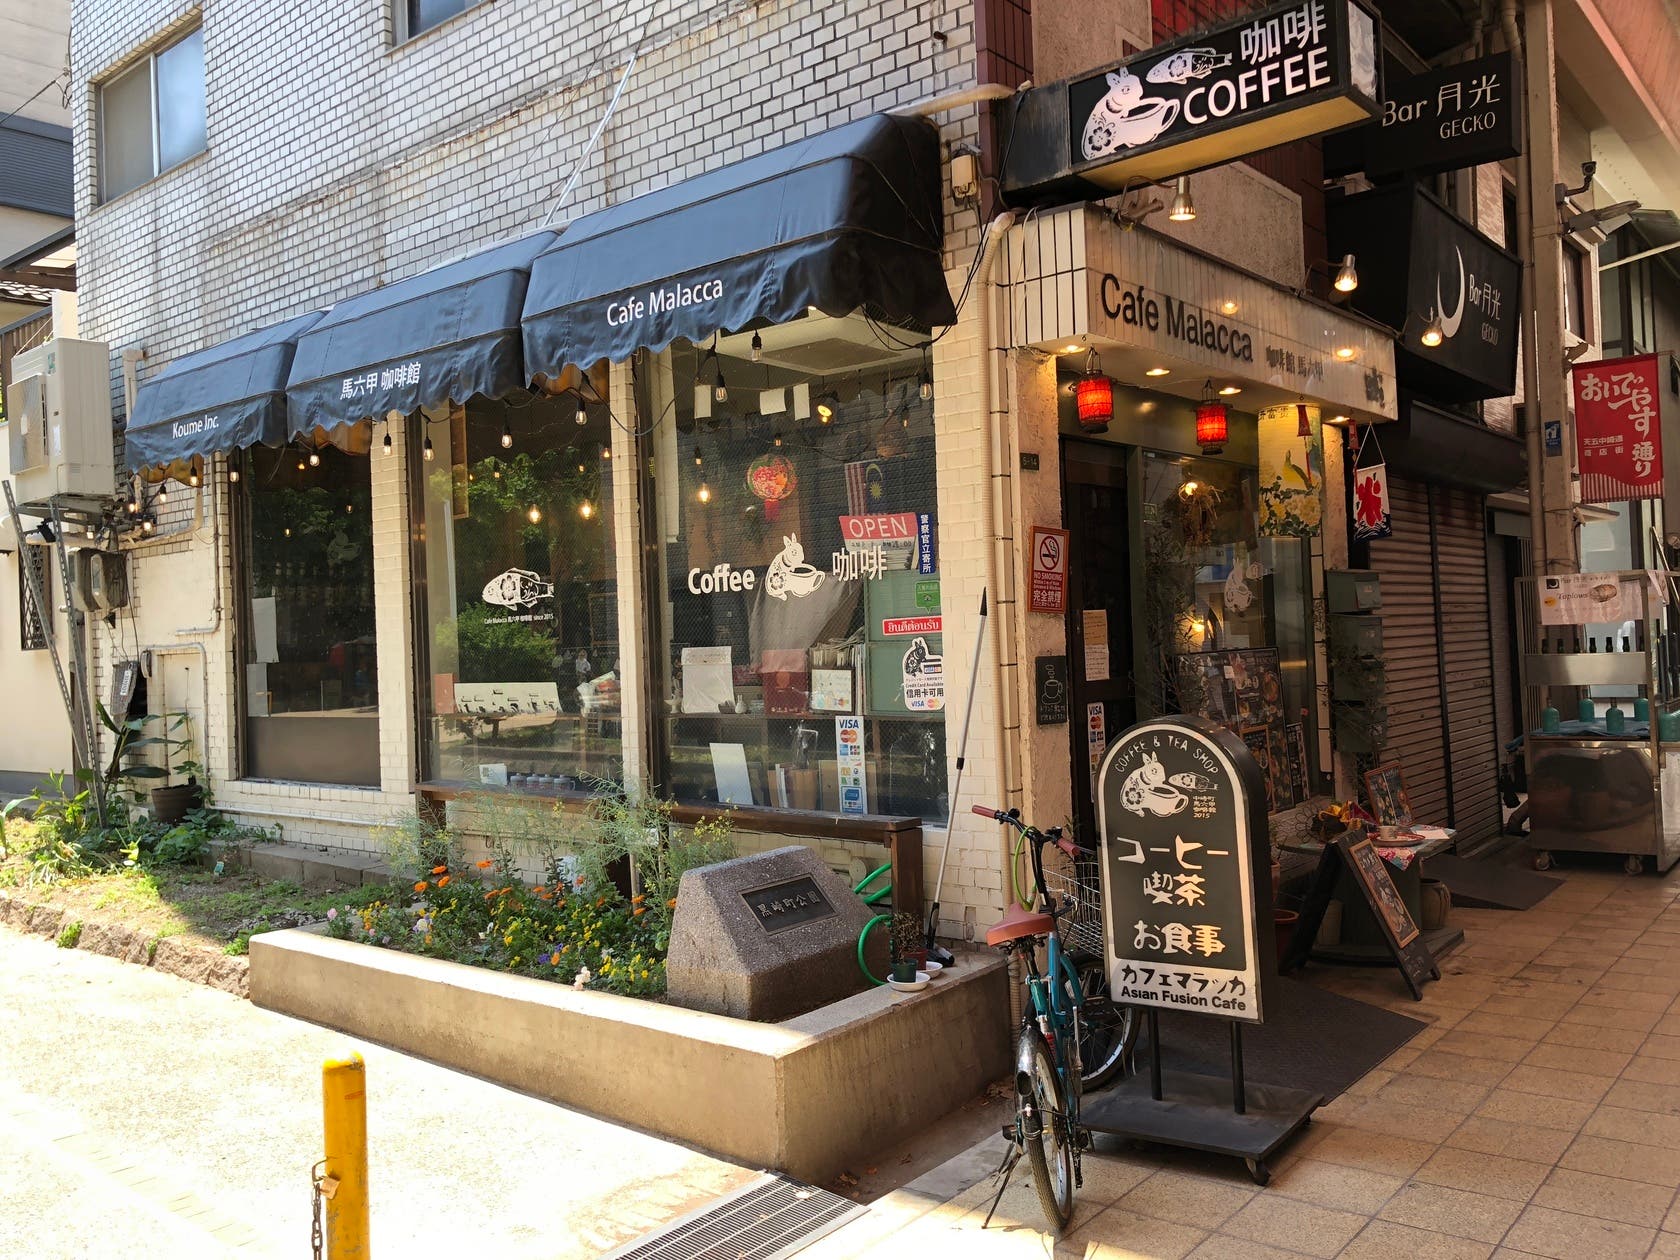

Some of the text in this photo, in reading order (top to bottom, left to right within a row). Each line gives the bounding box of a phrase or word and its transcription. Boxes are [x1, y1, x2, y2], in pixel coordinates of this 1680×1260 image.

[1240, 1, 1327, 65] 咖啡
[1183, 46, 1331, 125] COFFEE
[1382, 74, 1500, 127] Bar 月光
[1440, 111, 1496, 139] GECKO
[606, 279, 723, 327] Cafe Malacca
[1469, 273, 1500, 320] Bar 月光
[1101, 273, 1253, 362] Cafe Malacca
[340, 362, 422, 400] 馬六甲 咖啡館
[172, 415, 220, 439] Koume Inc.
[1356, 476, 1382, 527] 氷
[849, 516, 908, 538] OPEN
[920, 514, 932, 574] 警察官立寄所
[687, 545, 888, 595] Coffee 咖啡
[906, 688, 944, 698] 信用卡可用
[1090, 705, 1102, 715] VISA
[839, 719, 860, 729] VISA
[1114, 735, 1219, 774] COFFEE & TEA SHOP
[1116, 834, 1229, 869] コーヒー
[1143, 870, 1206, 906] 喫茶
[1133, 920, 1226, 957] お食事
[1121, 964, 1247, 997] カフェマラッカ
[1121, 985, 1247, 1011] Asian Fusion Cafe
